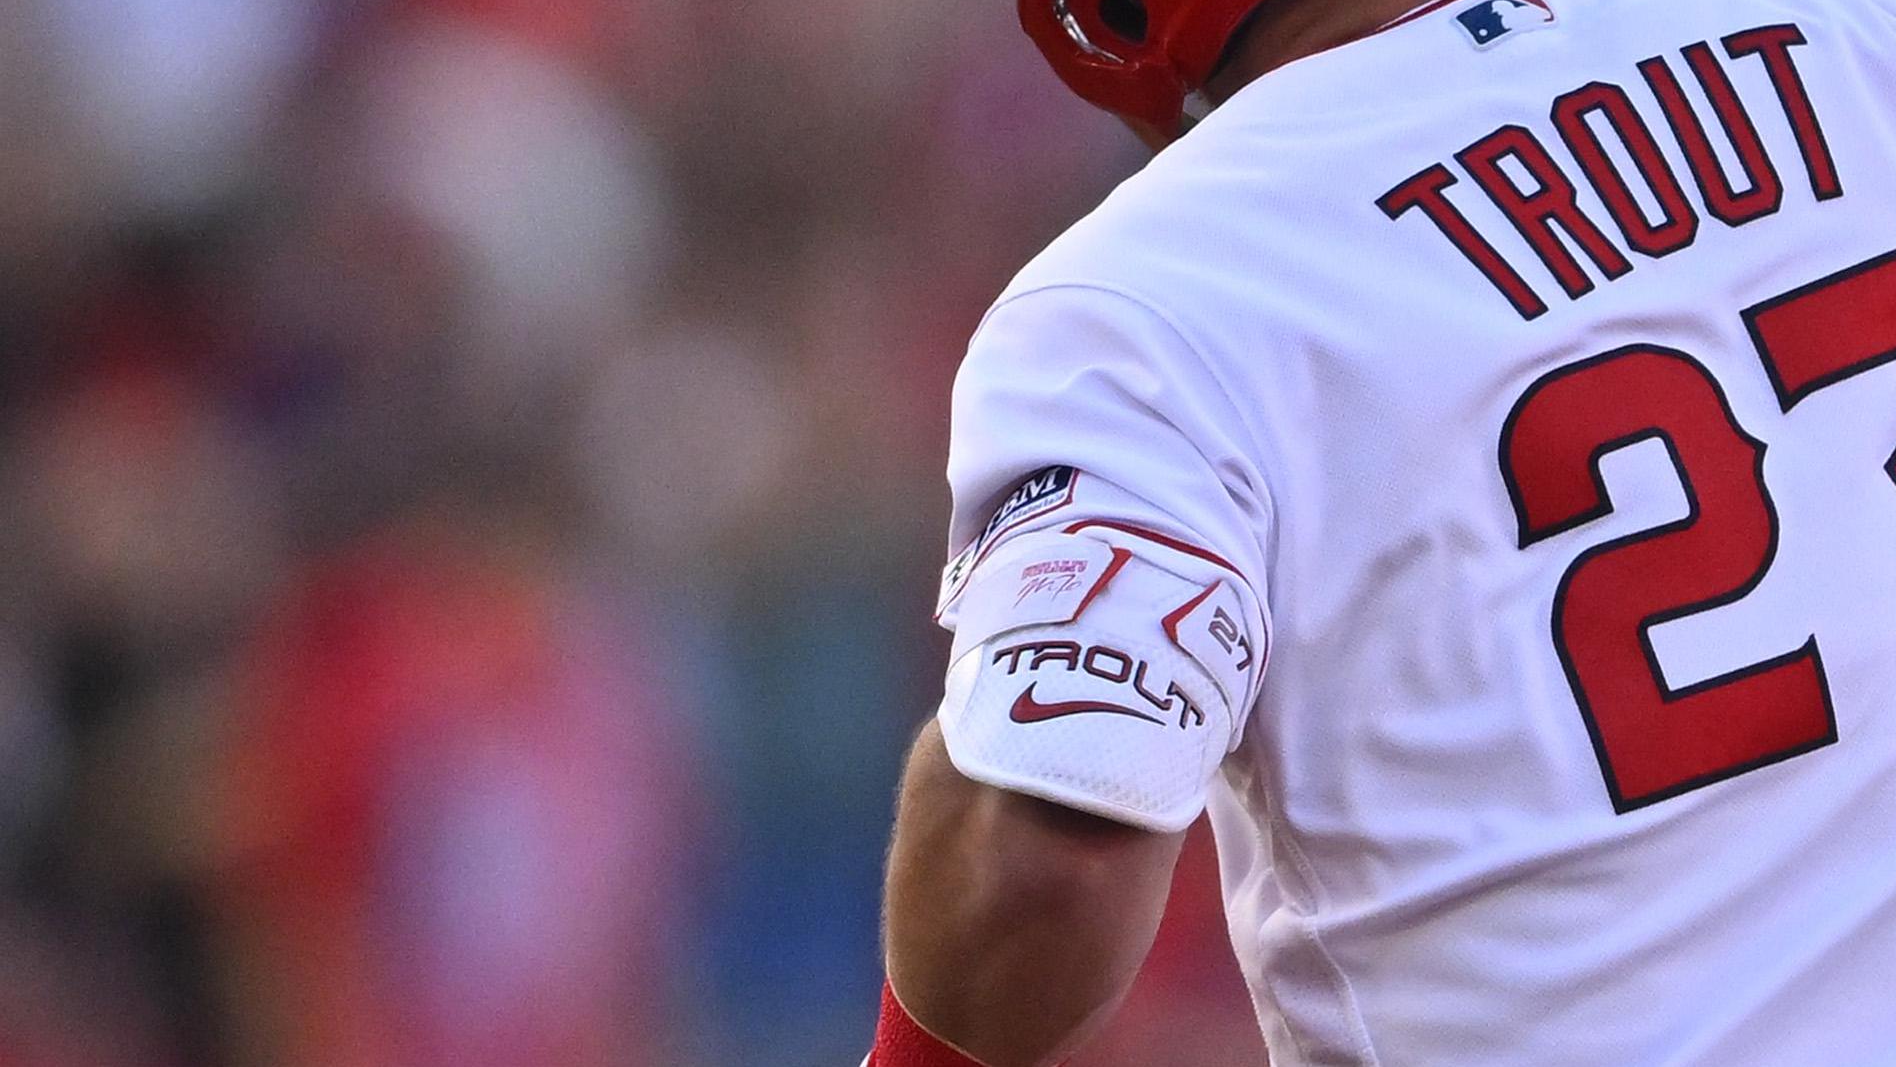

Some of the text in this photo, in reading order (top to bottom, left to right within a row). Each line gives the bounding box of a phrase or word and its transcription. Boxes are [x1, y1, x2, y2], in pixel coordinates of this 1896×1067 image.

[1374, 22, 1843, 321] TROUT
[1207, 605, 1254, 672] 27
[992, 640, 1206, 730] TROUT
